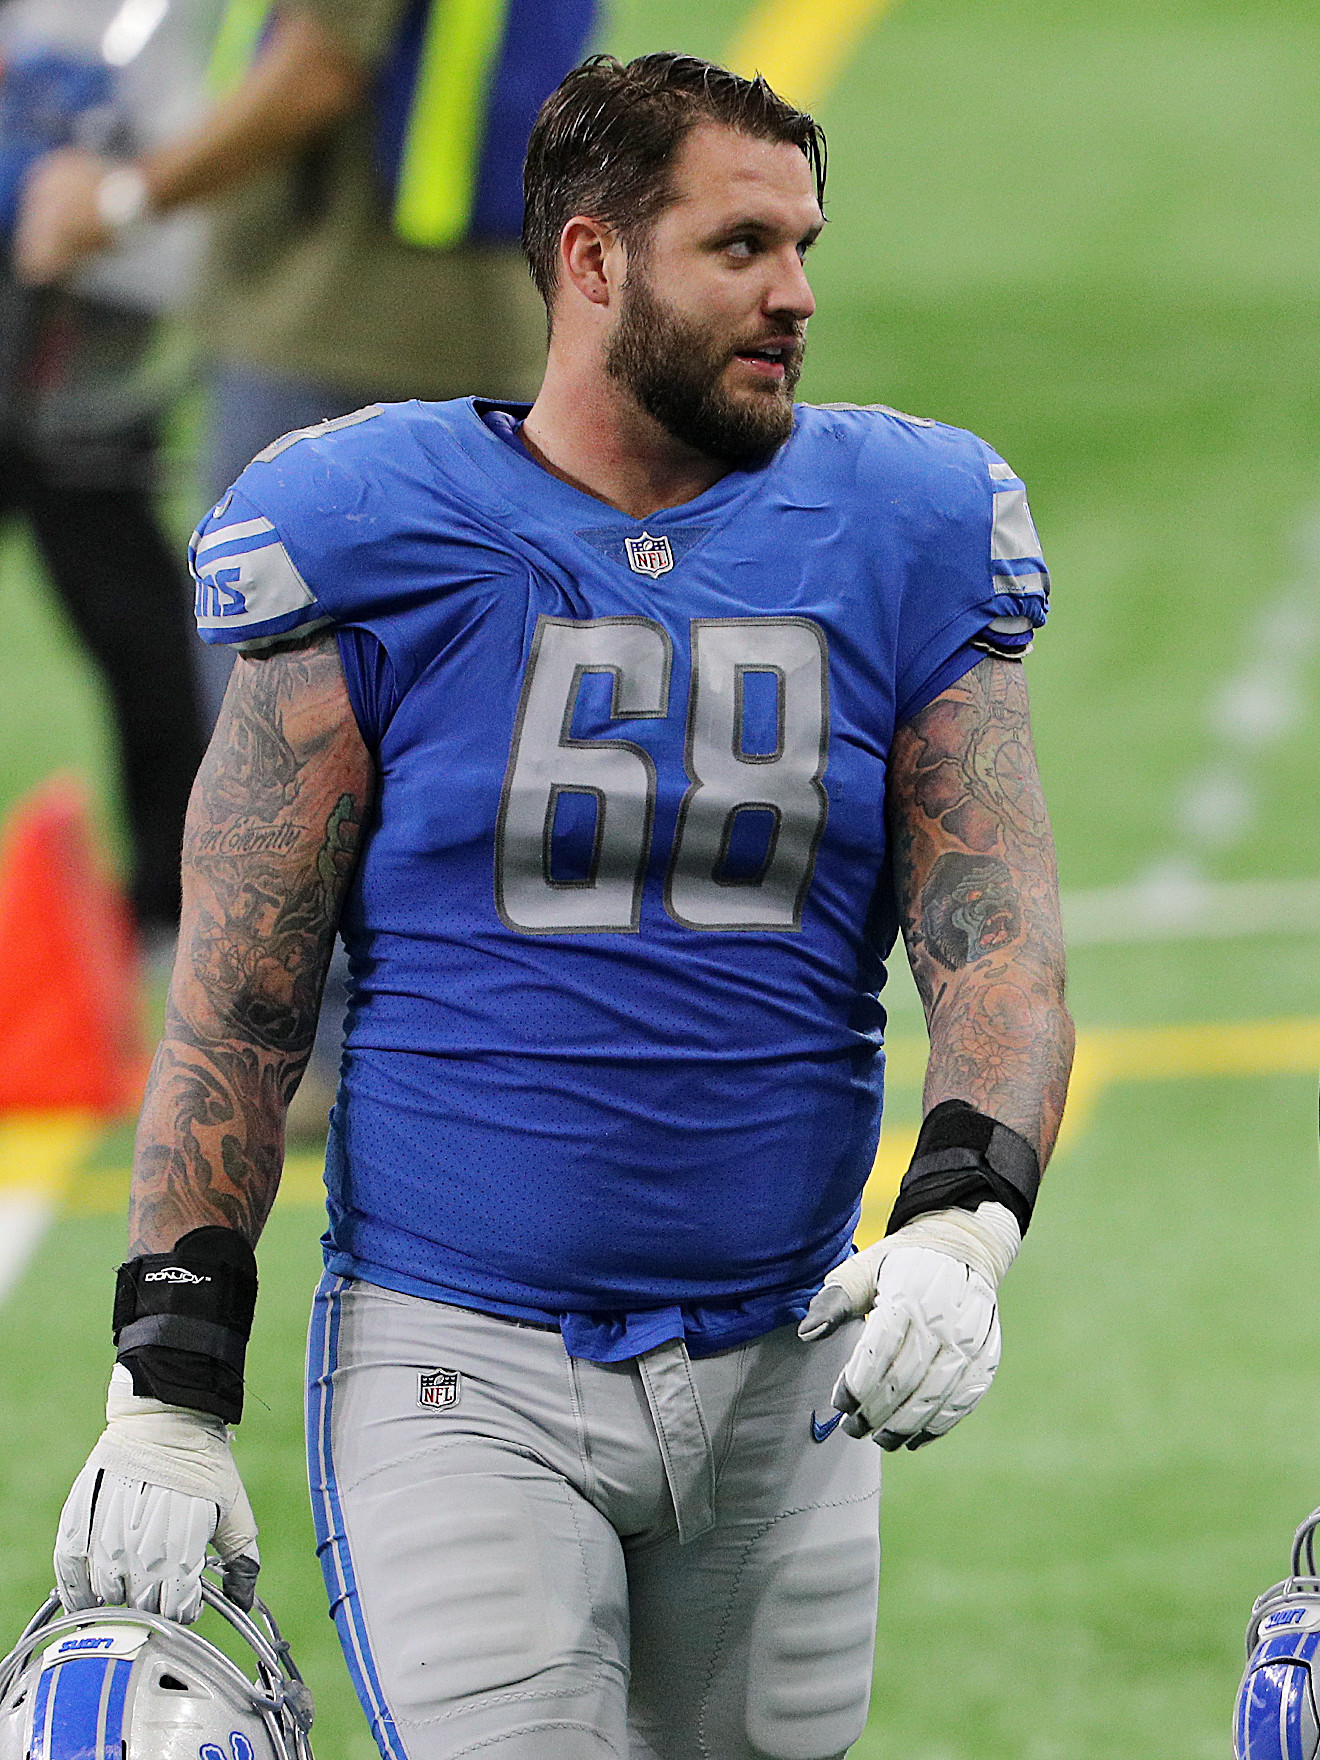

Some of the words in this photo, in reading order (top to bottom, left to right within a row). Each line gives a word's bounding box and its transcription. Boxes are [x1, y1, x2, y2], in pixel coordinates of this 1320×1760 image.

[636, 552, 667, 569] NFL
[494, 613, 830, 936] 68
[424, 1387, 453, 1404] NFL
